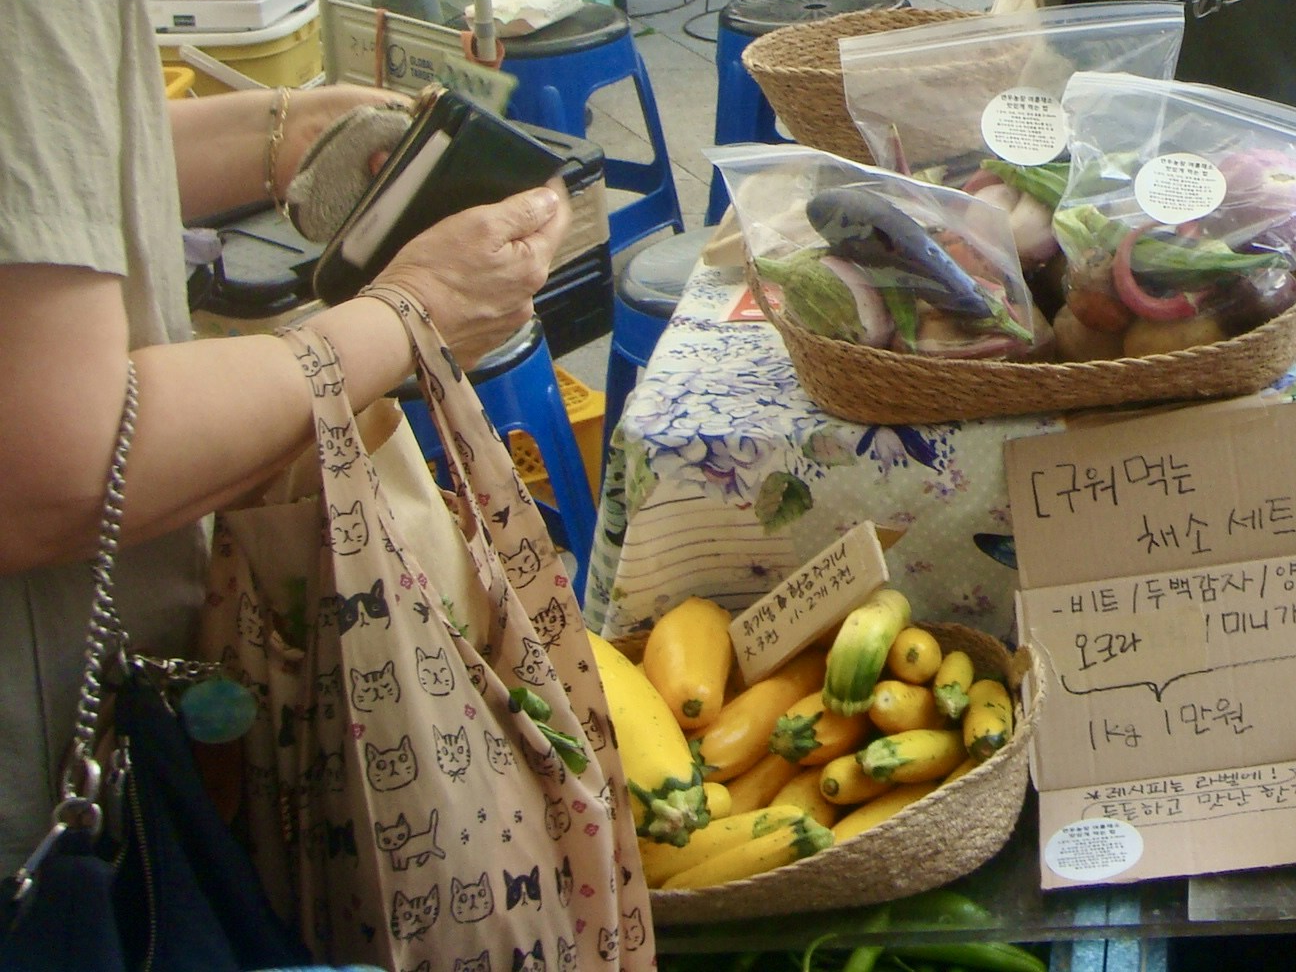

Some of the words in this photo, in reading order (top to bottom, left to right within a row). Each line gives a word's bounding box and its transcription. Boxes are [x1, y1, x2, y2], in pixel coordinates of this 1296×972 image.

[1136, 513, 1212, 555] 채소
[1074, 631, 1143, 672] 오크라
[1197, 789, 1252, 812] 맛난
